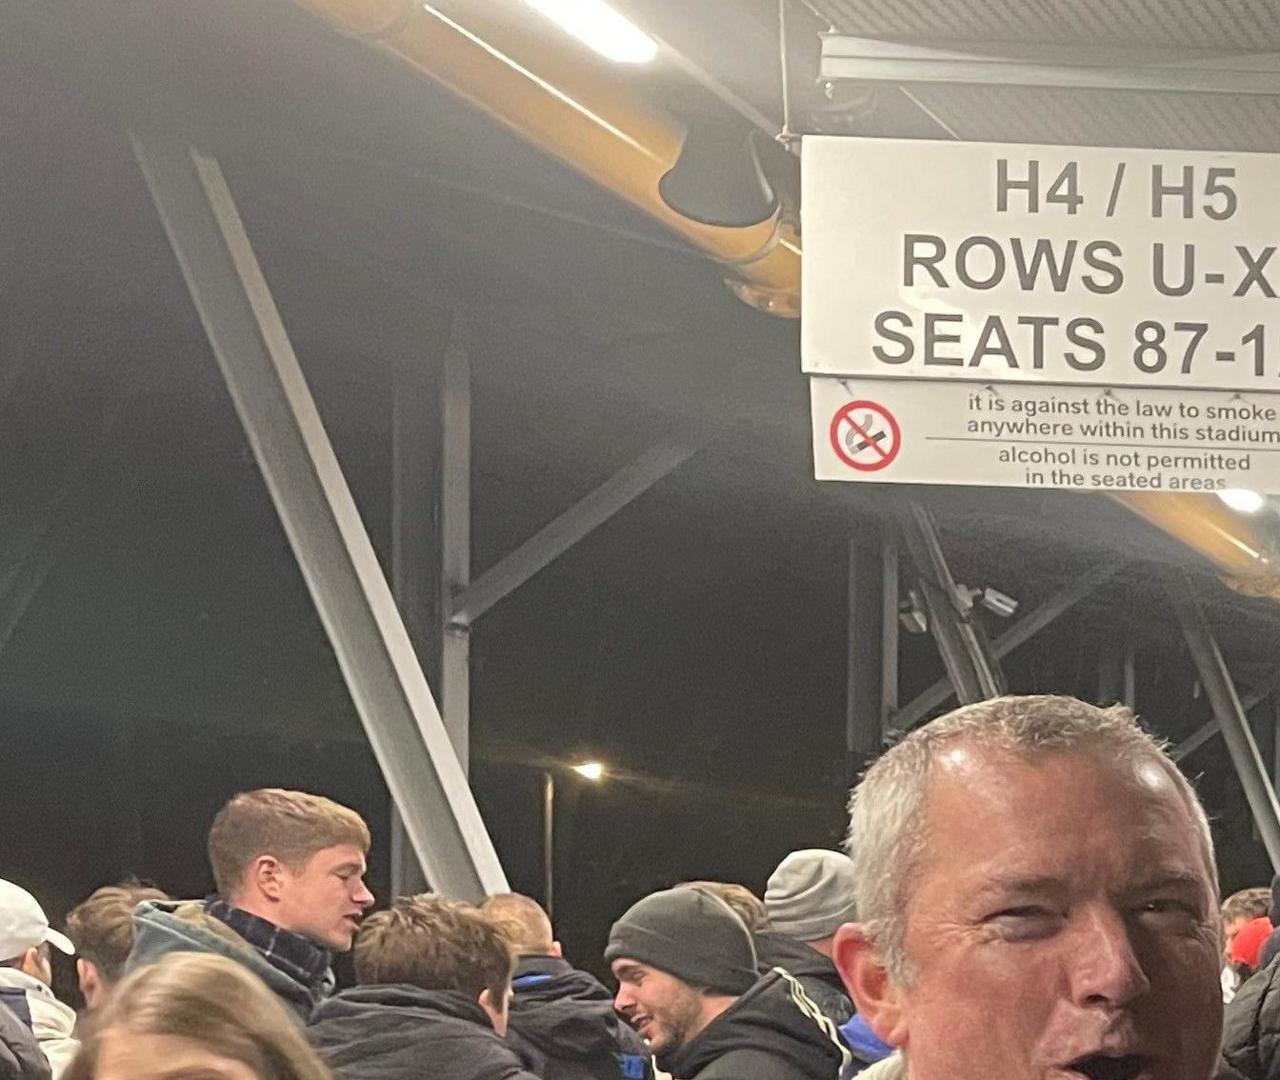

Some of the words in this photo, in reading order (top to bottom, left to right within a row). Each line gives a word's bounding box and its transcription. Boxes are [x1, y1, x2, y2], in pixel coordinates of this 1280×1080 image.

[996, 158, 1084, 215] H4
[1106, 162, 1126, 217] /
[1151, 164, 1237, 221] H5
[903, 233, 1124, 295] ROWS
[872, 311, 1106, 372] SEATS
[969, 394, 982, 411] it
[988, 396, 1005, 412] is
[1012, 397, 1091, 416] against
[1096, 399, 1129, 416] the
[1136, 400, 1172, 417] law
[1179, 402, 1199, 418] to
[1207, 404, 1276, 421] smoke
[968, 418, 1073, 437] anywhere
[1080, 421, 1145, 439] within
[1152, 423, 1189, 440] this
[1196, 425, 1280, 443] stadium
[999, 446, 1076, 465] alcohol
[1083, 449, 1099, 465] is
[1106, 452, 1140, 467] not
[1147, 453, 1250, 471] permitted
[1025, 468, 1044, 484] in
[1051, 469, 1084, 486] the
[1091, 472, 1161, 488] seated
[1169, 476, 1226, 490] areas
